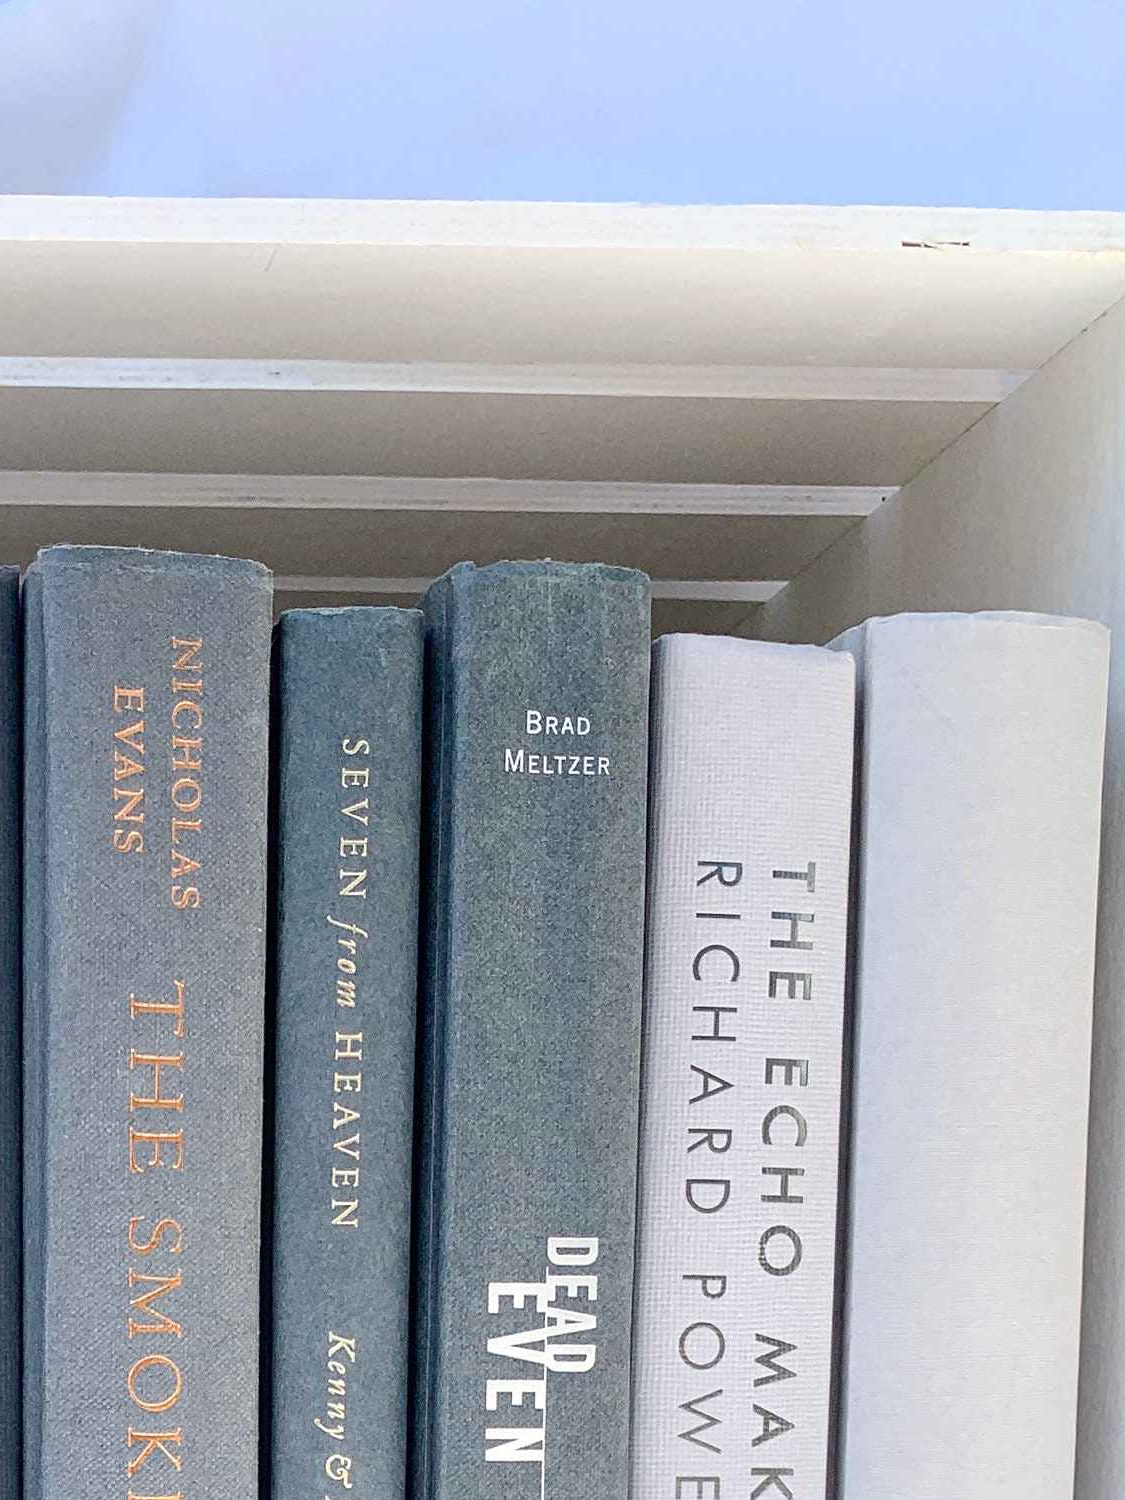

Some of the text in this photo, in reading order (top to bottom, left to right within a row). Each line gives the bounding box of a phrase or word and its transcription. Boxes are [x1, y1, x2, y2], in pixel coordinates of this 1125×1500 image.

[113, 684, 144, 854] EVANS
[171, 635, 203, 910] NICHOLAS
[327, 737, 370, 1229] SEVEN from HEAVEN
[768, 861, 817, 1003] THE
[130, 980, 184, 1173] THE
[688, 859, 743, 1217] RICHARD
[759, 1056, 809, 1279] ECHO
[314, 1331, 355, 1440] Kenny
[485, 1282, 550, 1462] EVEN
[546, 1237, 599, 1373] DEAD
[325, 1454, 352, 1488] &
